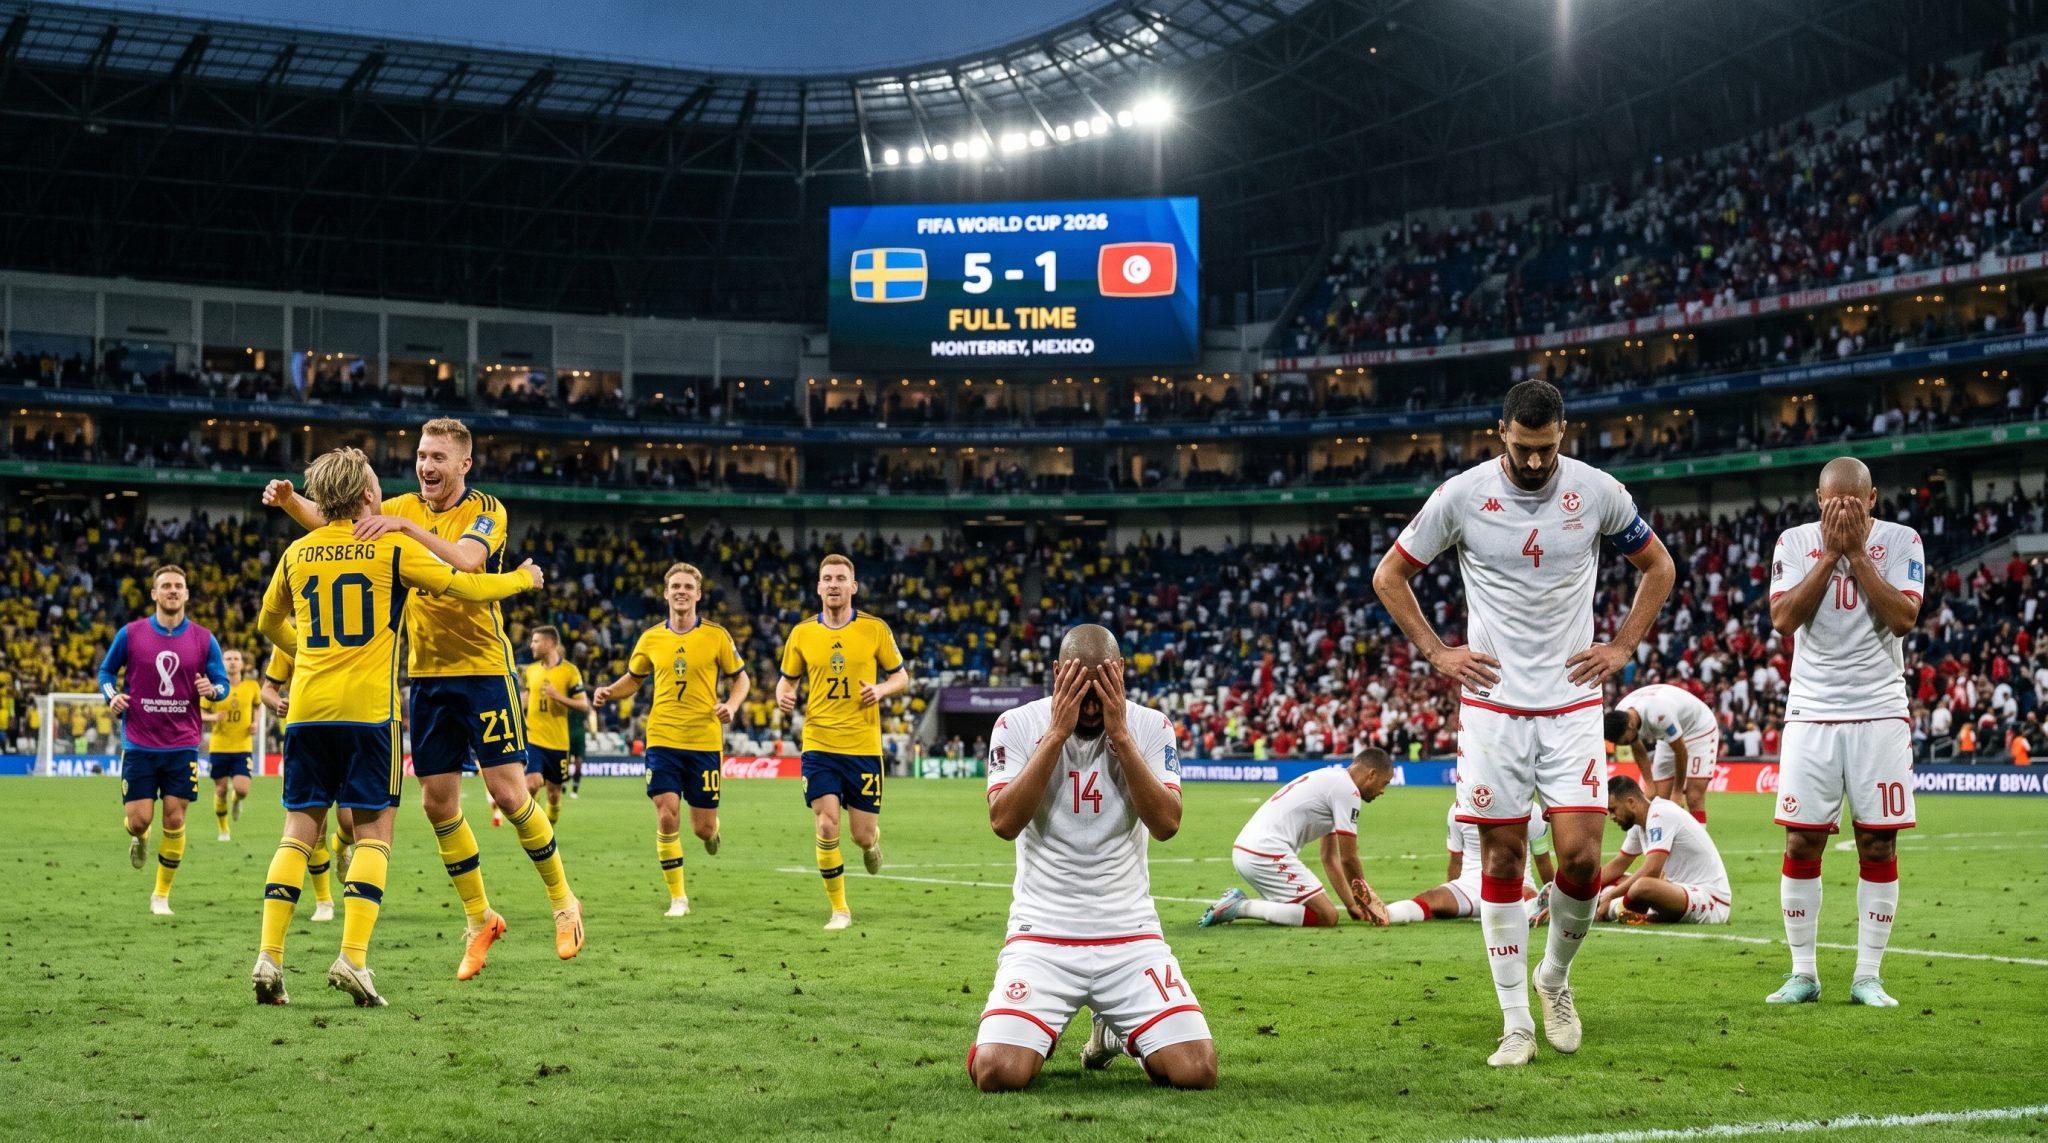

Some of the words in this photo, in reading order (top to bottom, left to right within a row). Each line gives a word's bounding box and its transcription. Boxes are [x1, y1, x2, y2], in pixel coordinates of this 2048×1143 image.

[917, 217, 956, 235] FIFA
[957, 215, 1023, 233] WORLD
[1024, 214, 1062, 232] CUP
[1063, 212, 1109, 231] 2026
[962, 252, 993, 294] 5
[1034, 250, 1057, 292] 1
[948, 308, 1011, 331] FULL
[1014, 306, 1077, 330] TIME
[931, 340, 1031, 357] MONTERREY,
[1032, 338, 1095, 355] MEXICO
[297, 543, 376, 563] FORSBERG
[1521, 528, 1545, 568] 4
[1831, 575, 1858, 610] 10
[300, 572, 376, 649] 10
[674, 680, 688, 701] 7
[826, 676, 852, 700] 21
[227, 710, 242, 723] 10
[479, 708, 514, 744] 21
[702, 769, 720, 792] 10
[861, 772, 881, 797] 21
[1581, 758, 1600, 798] 4
[1912, 772, 1998, 792] MONTERRY
[1999, 773, 2041, 793] BBVA
[1068, 770, 1103, 814] 14
[1877, 781, 1906, 818] 10
[1868, 911, 1894, 923] TUN
[1488, 944, 1519, 957] TUN
[1144, 963, 1188, 1003] 14
